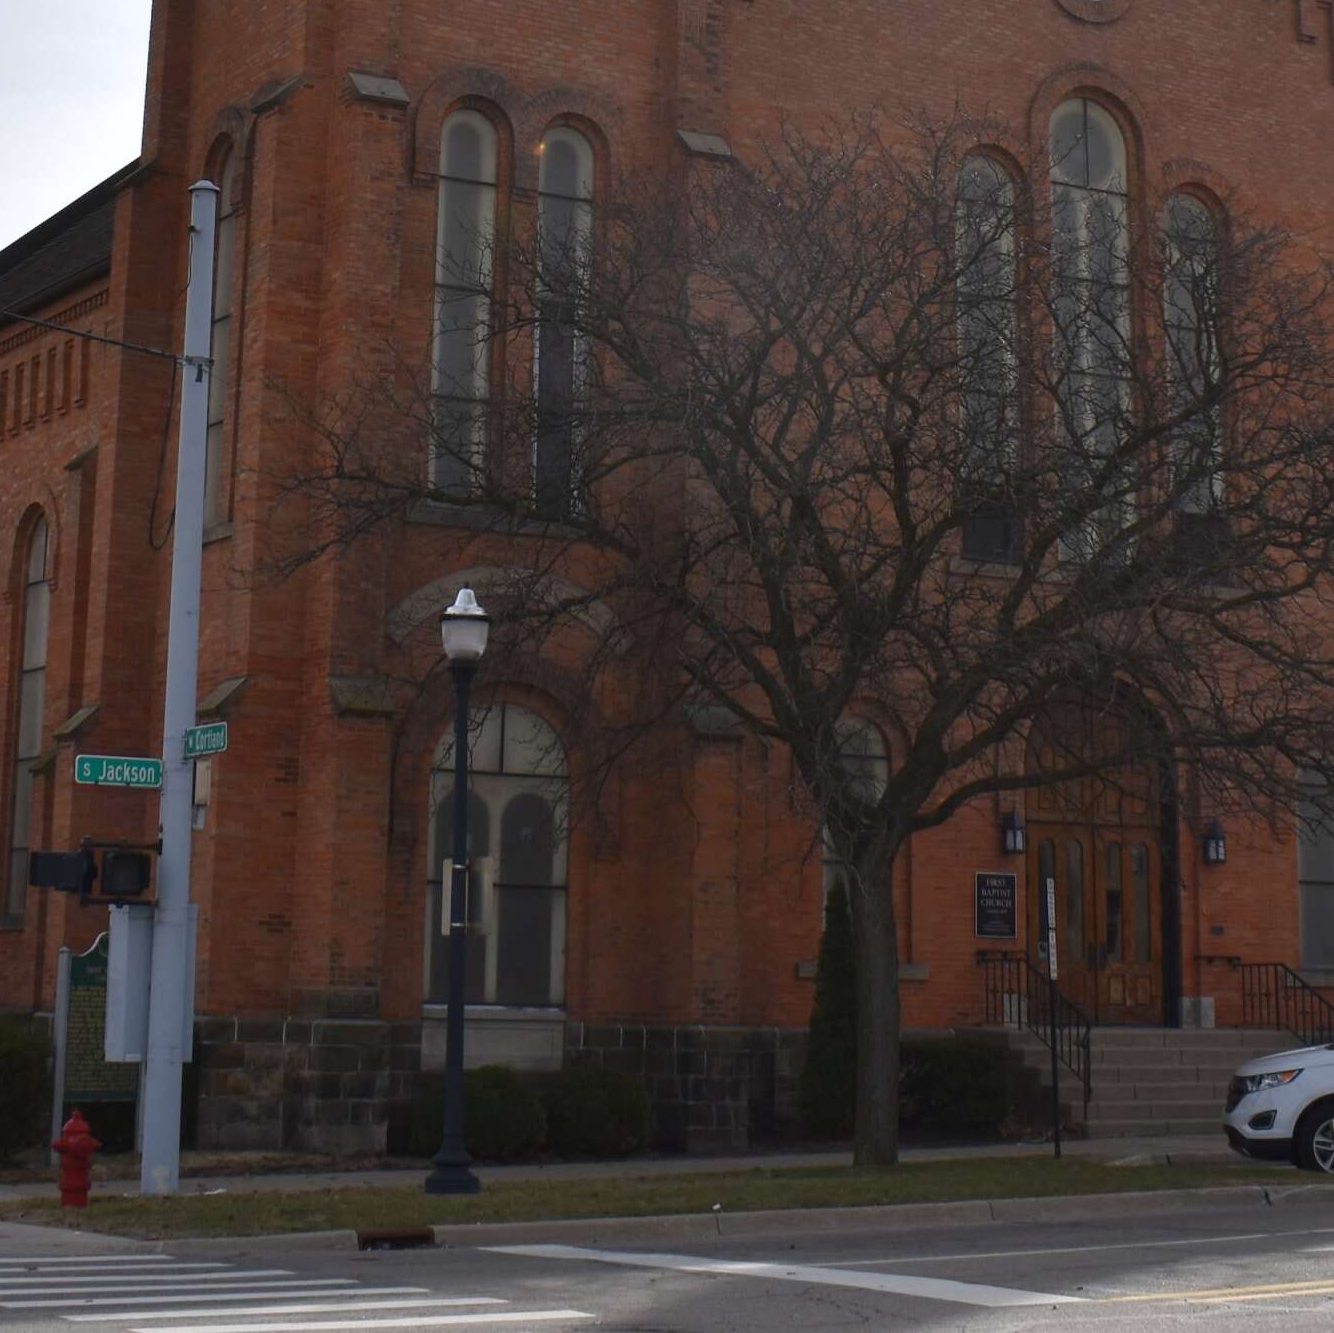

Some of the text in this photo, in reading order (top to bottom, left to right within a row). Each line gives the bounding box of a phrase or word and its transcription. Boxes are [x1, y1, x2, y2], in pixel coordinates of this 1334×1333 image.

[83, 759, 155, 783] S Jackson
[986, 878, 1006, 887] FIRST
[981, 889, 1011, 898] BAPTIST
[980, 898, 1012, 908] CHURCH
